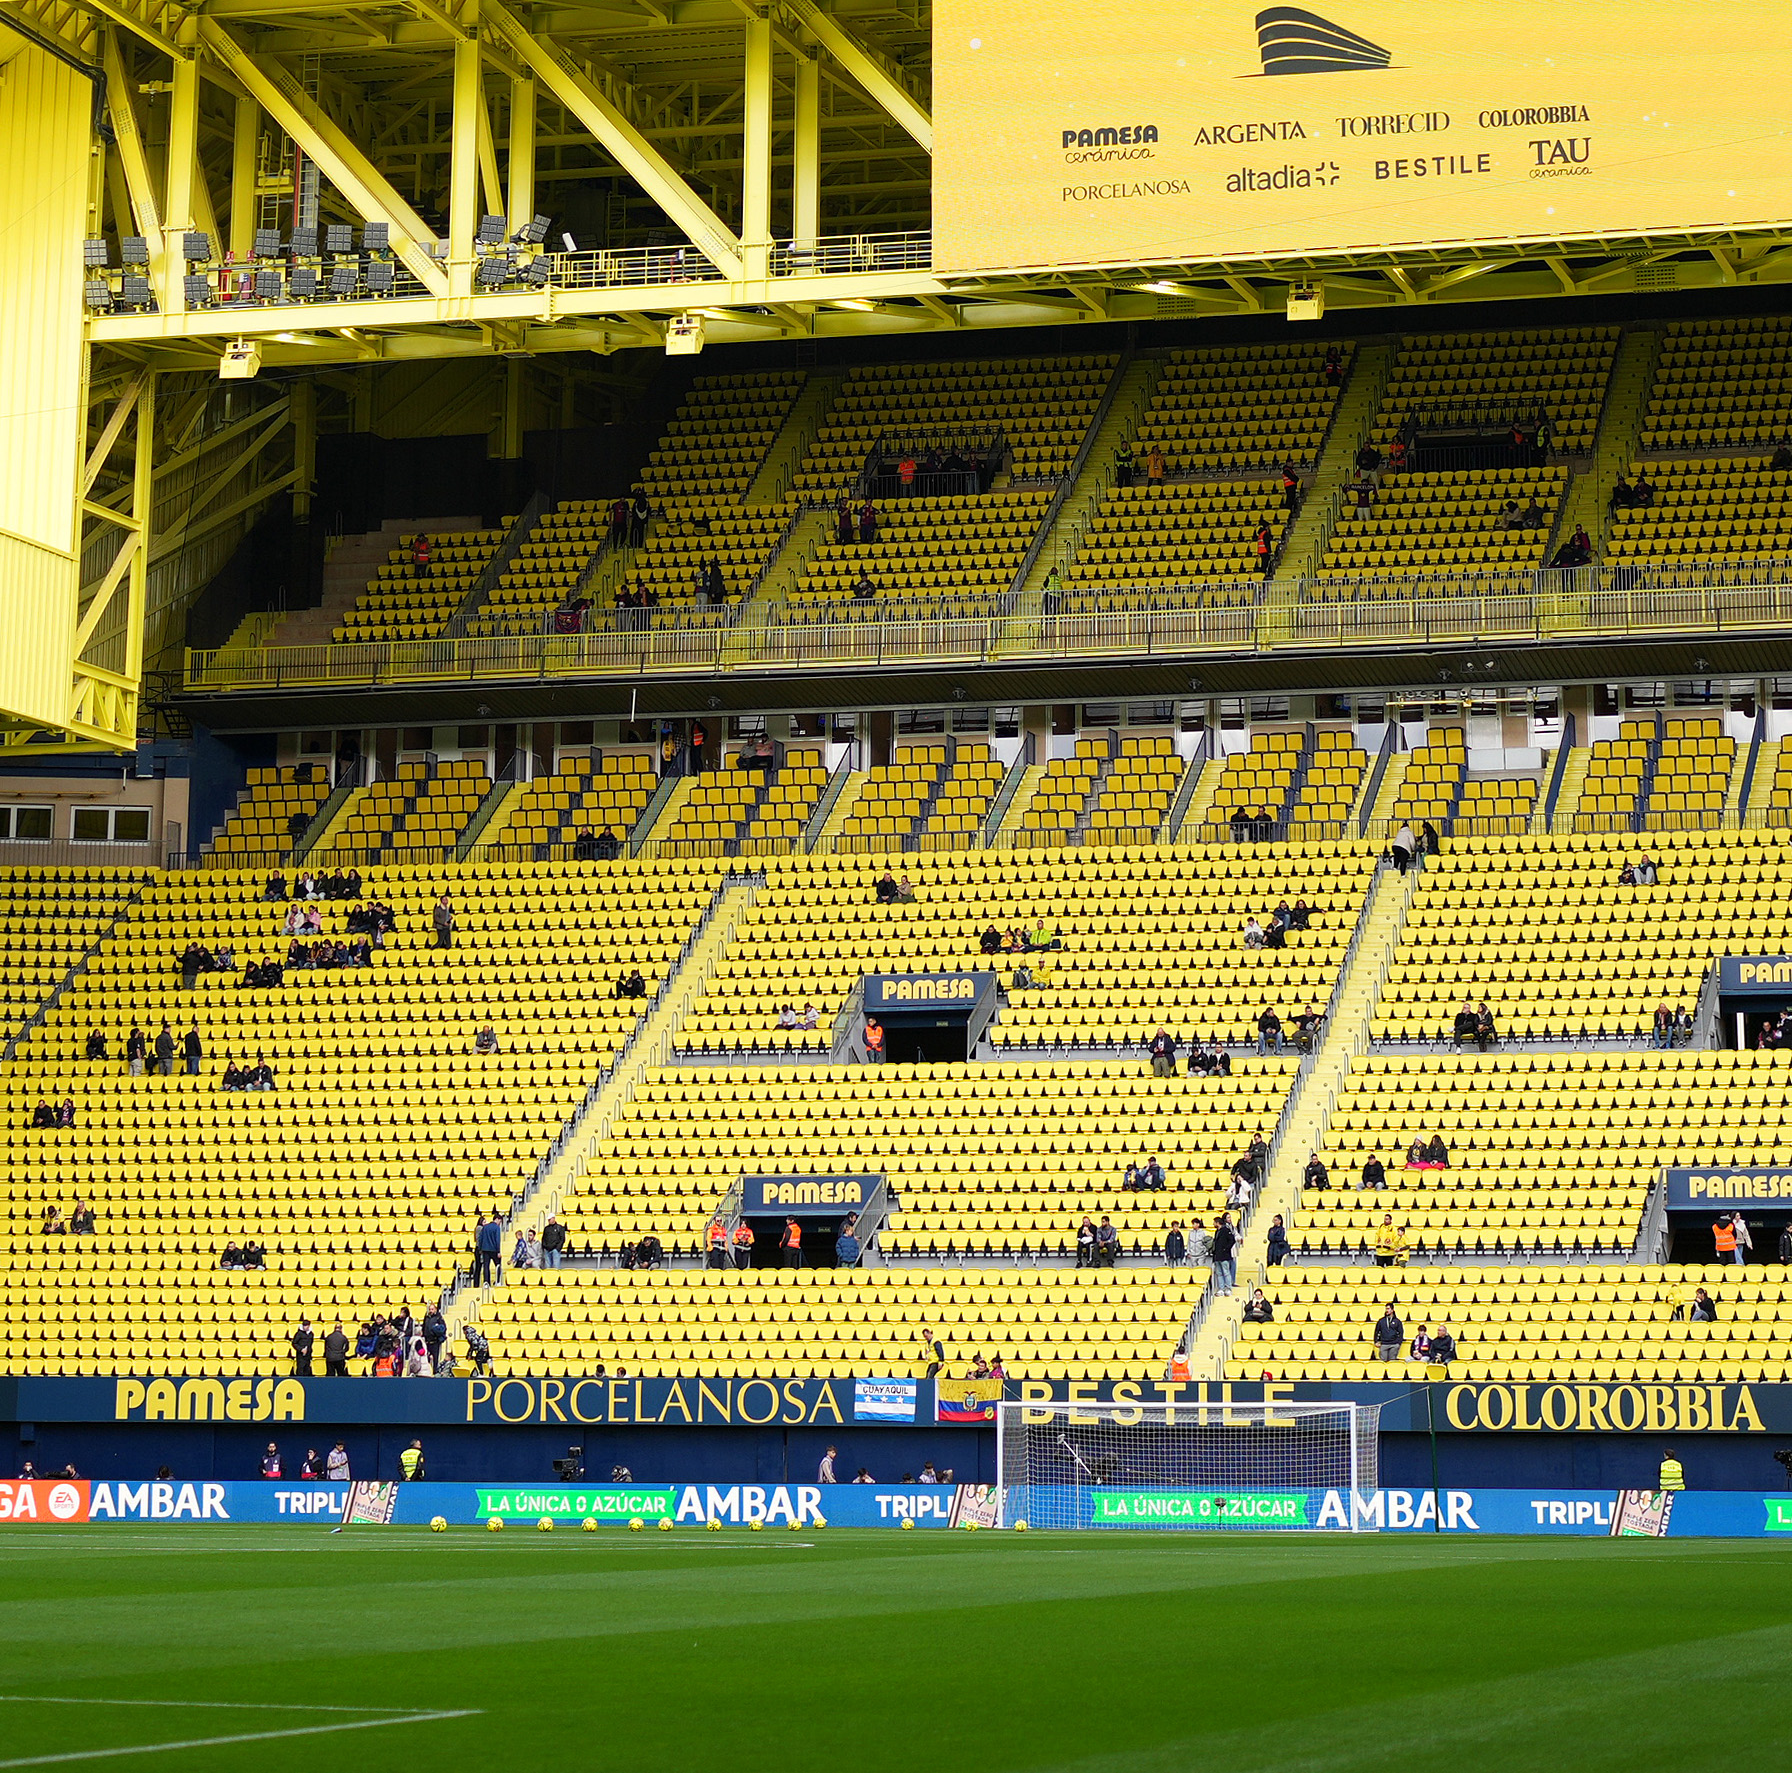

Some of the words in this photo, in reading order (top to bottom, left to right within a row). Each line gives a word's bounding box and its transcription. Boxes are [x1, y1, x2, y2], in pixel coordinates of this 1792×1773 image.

[1336, 111, 1450, 138] TORRECID
[1478, 104, 1590, 129] COLOROBBIA
[1062, 124, 1159, 149] PAMESA
[1193, 120, 1307, 146] ARGENTA
[1528, 137, 1592, 166] TAU
[1226, 164, 1311, 194] altadia
[1375, 153, 1491, 180] BESTILE
[1062, 179, 1191, 202] PORCELANOSA
[882, 978, 975, 1000] PAMESA
[762, 1181, 862, 1205] PAMESA
[115, 1378, 305, 1421] PAMESA
[465, 1379, 844, 1424] PORCELANOSA
[862, 1385, 909, 1395] GUAYAQUIL
[1021, 1381, 1296, 1427] BESTILE
[1446, 1384, 1766, 1431] COLOROBBIA
[89, 1483, 230, 1519] AMBAR
[486, 1496, 509, 1512] LA
[515, 1492, 571, 1513] ÚNICA
[592, 1493, 666, 1514] AZÚCAR
[1104, 1498, 1129, 1515] LA
[1134, 1495, 1193, 1516] ÚNICA
[1316, 1489, 1480, 1530] AMBAR
